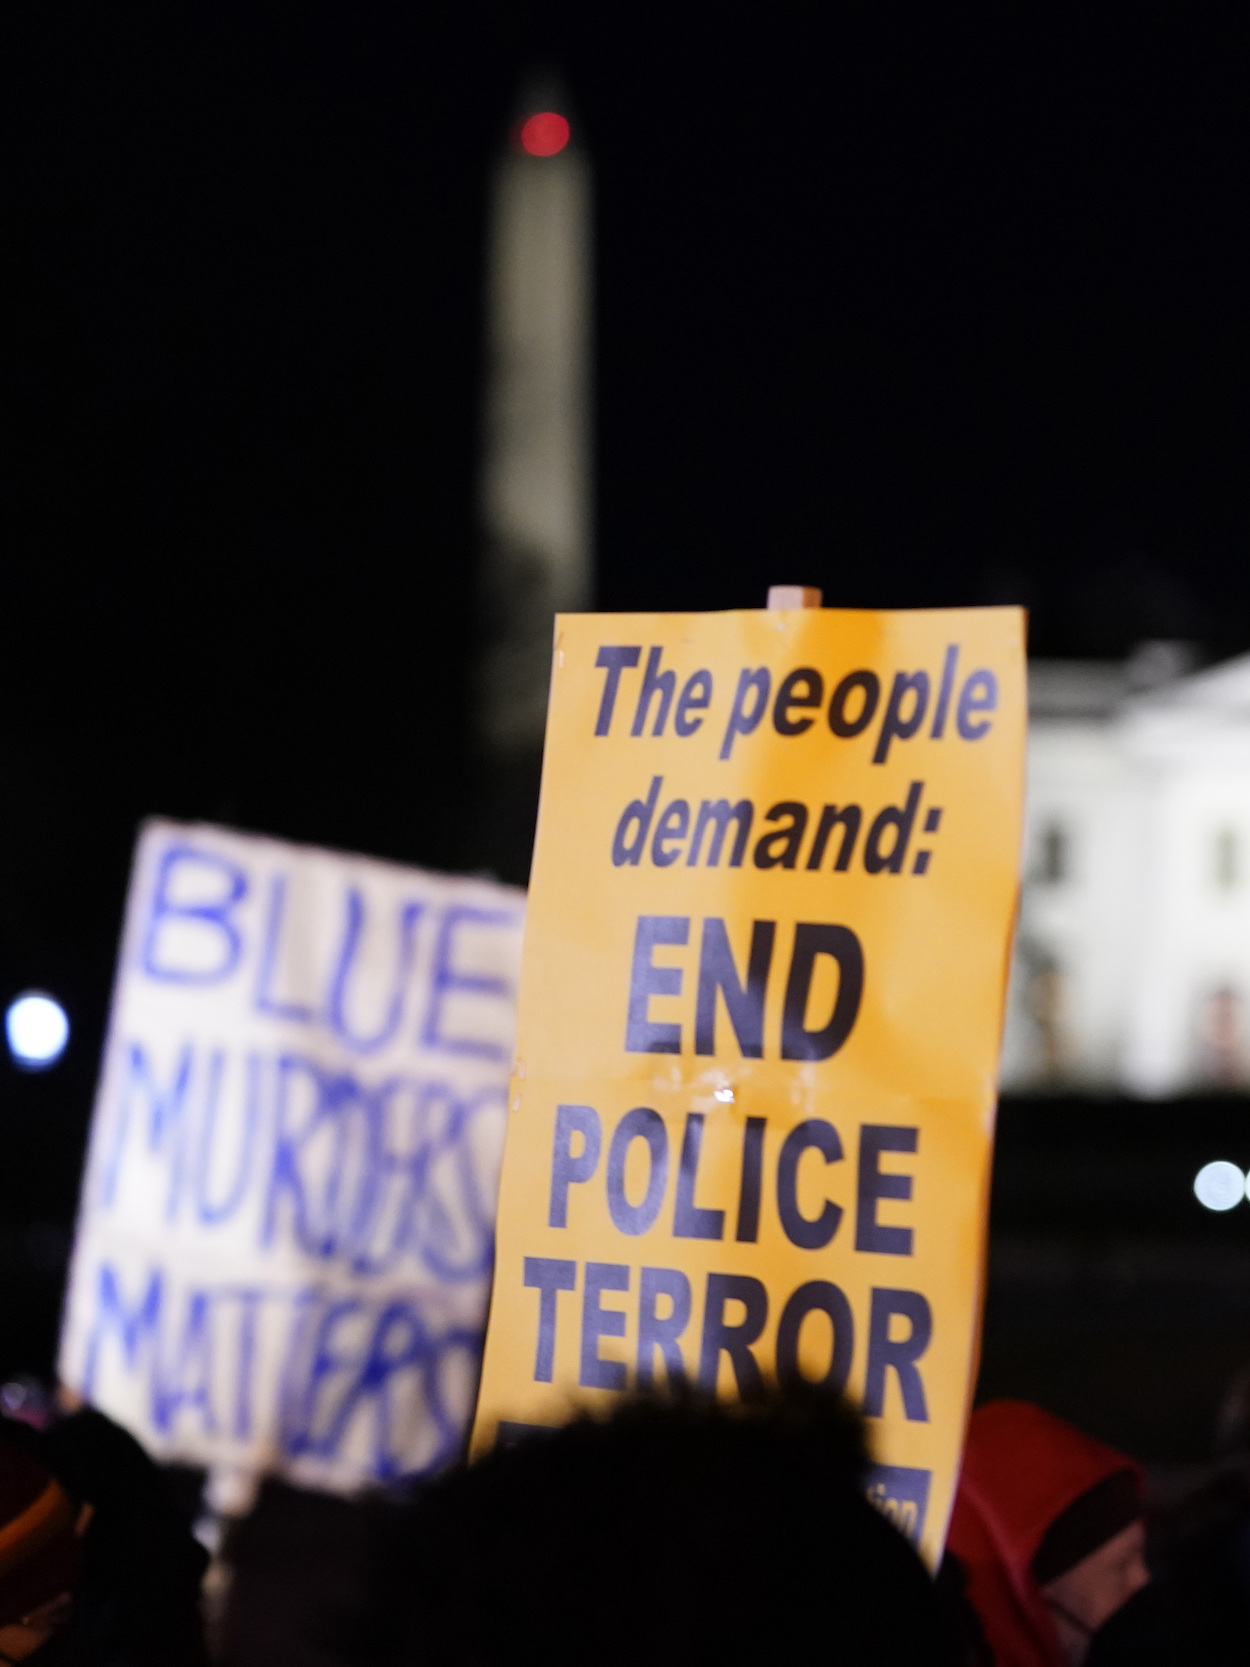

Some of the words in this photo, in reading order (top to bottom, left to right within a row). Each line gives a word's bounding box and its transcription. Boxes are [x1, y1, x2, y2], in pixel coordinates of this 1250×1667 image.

[593, 645, 713, 738] The
[718, 643, 999, 765] people
[610, 775, 944, 876] demand:
[139, 837, 524, 1062] BLUE
[624, 914, 866, 1061] END
[548, 1103, 920, 1257] POLICE
[523, 1256, 934, 1423] TERROR
